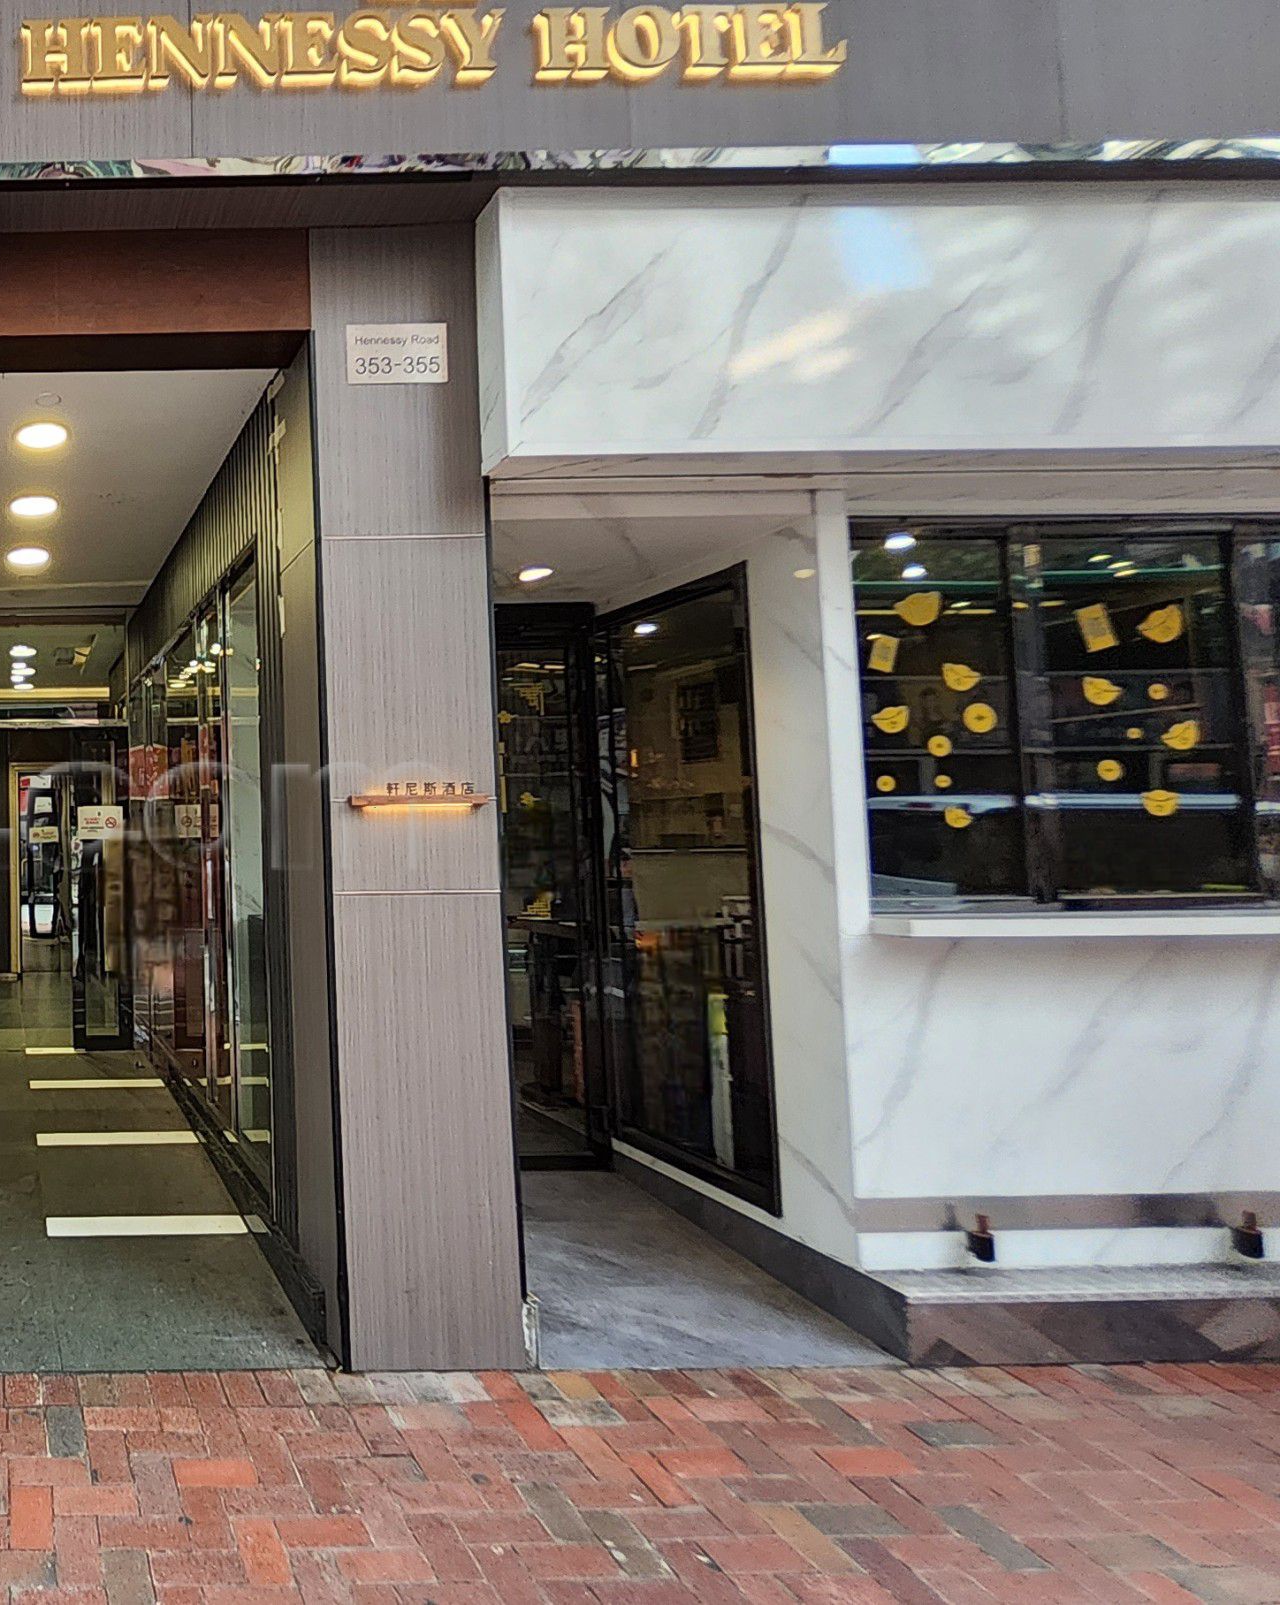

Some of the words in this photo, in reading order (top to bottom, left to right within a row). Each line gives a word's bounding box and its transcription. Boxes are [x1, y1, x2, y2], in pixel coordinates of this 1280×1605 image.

[20, 7, 506, 95] HENNESSY
[532, 2, 848, 83] HOTEL
[354, 335, 408, 347] Hennessy
[410, 334, 440, 345] Road
[355, 356, 440, 375] 353-355
[386, 781, 475, 796] 軒尼斯酒店
